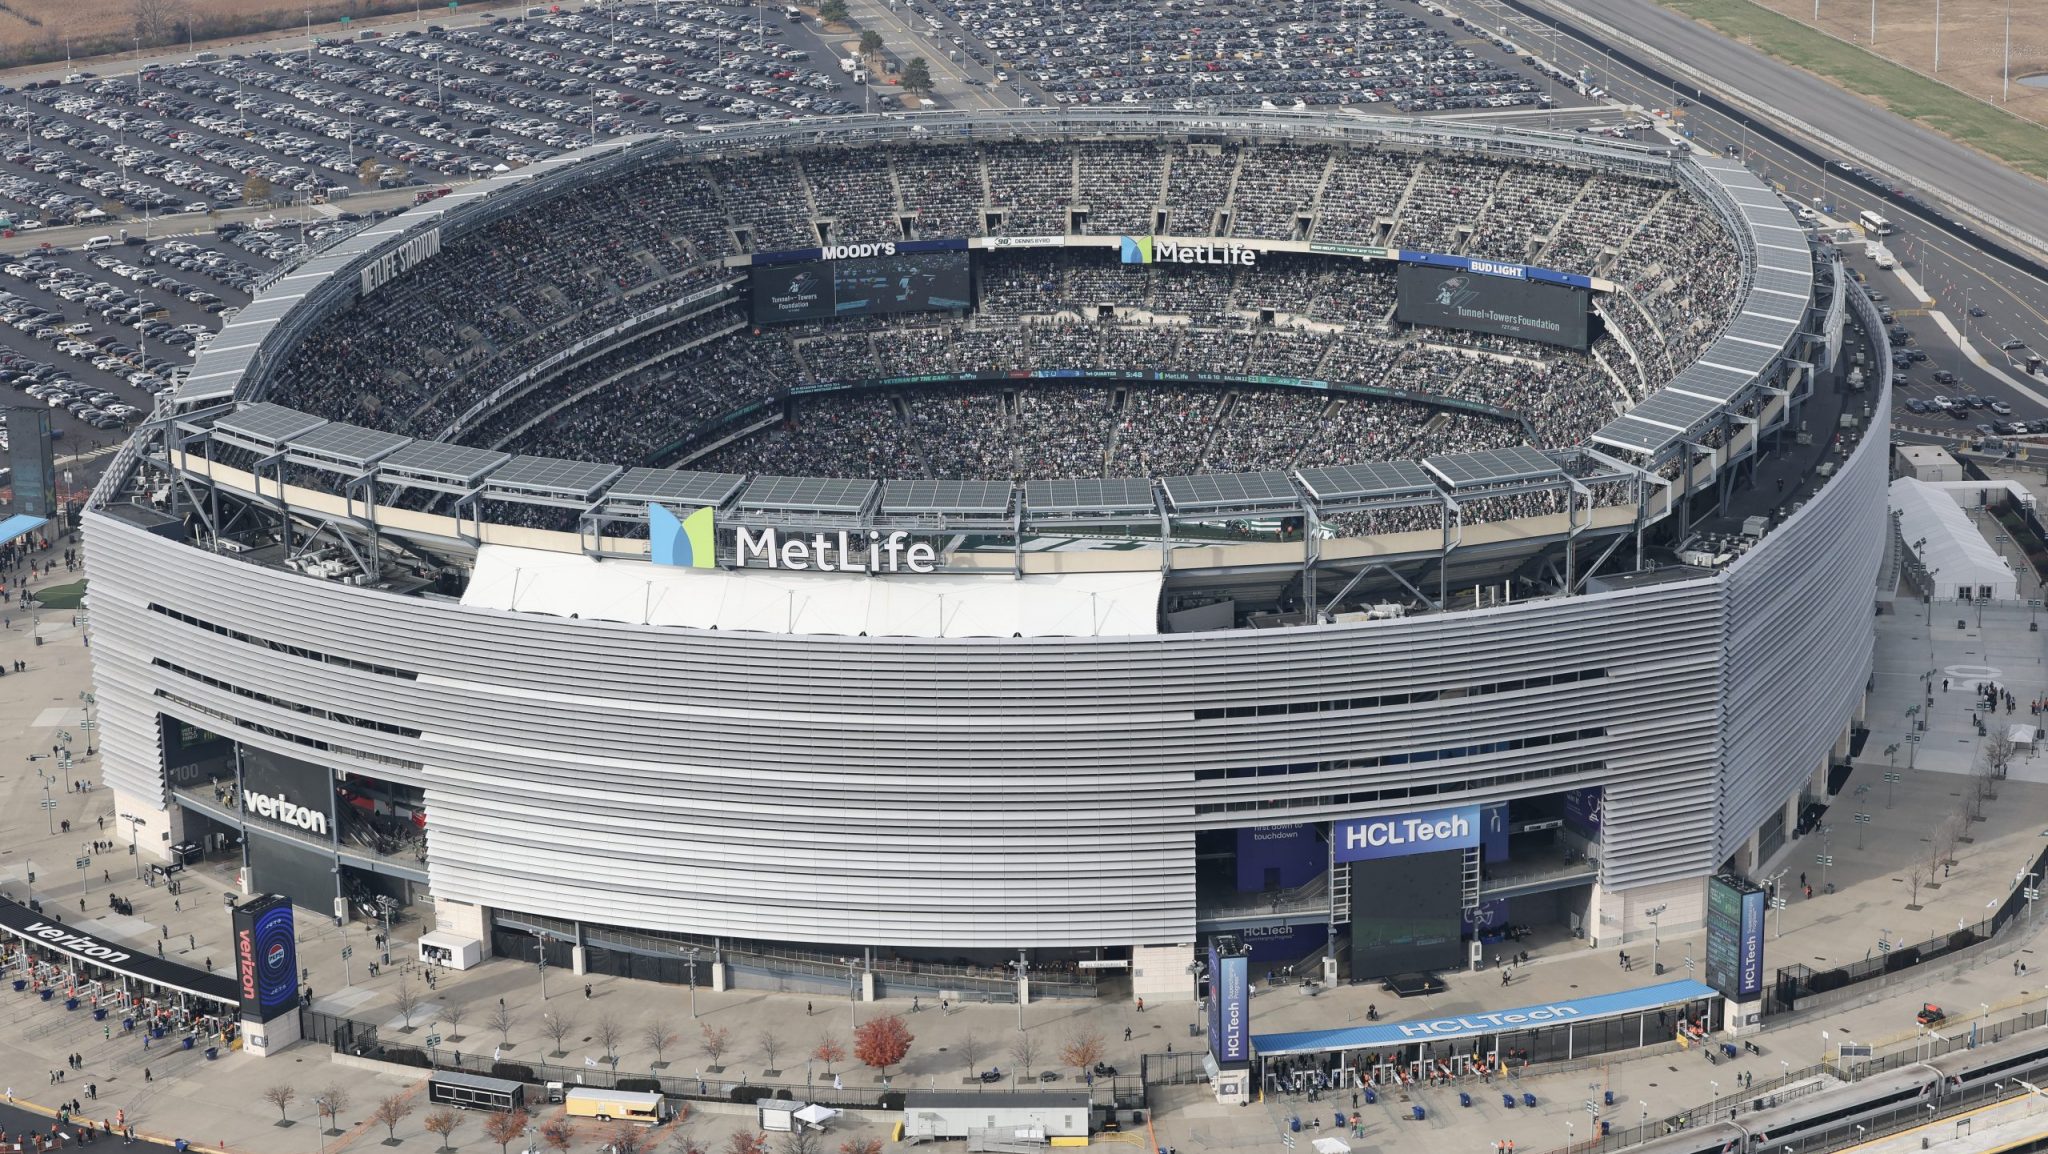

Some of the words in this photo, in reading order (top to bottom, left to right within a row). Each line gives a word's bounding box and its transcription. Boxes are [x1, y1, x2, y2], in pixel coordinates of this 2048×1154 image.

[361, 250, 398, 296] METLIFE
[398, 226, 440, 272] STADIUM
[822, 242, 896, 260] MOODY'S
[1156, 242, 1256, 266] MetLife
[1471, 261, 1498, 273] BUD
[1498, 264, 1523, 277] LIGHT
[778, 301, 809, 310] Foundation
[1457, 305, 1484, 319] Tunnel
[1489, 310, 1518, 325] Towers
[1518, 313, 1560, 332] Foundation
[736, 526, 937, 574] MetLife
[175, 763, 199, 781] 100
[244, 789, 327, 834] verizon
[1254, 831, 1298, 841] touchdown
[1347, 815, 1469, 850] HCLTech
[24, 922, 131, 963] verizon
[1244, 926, 1293, 937] HCLTech
[239, 929, 256, 1000] verizon
[1745, 936, 1756, 990] HCLTech
[1228, 1002, 1239, 1057] HCLTech
[1398, 1004, 1580, 1036] HCLTech
